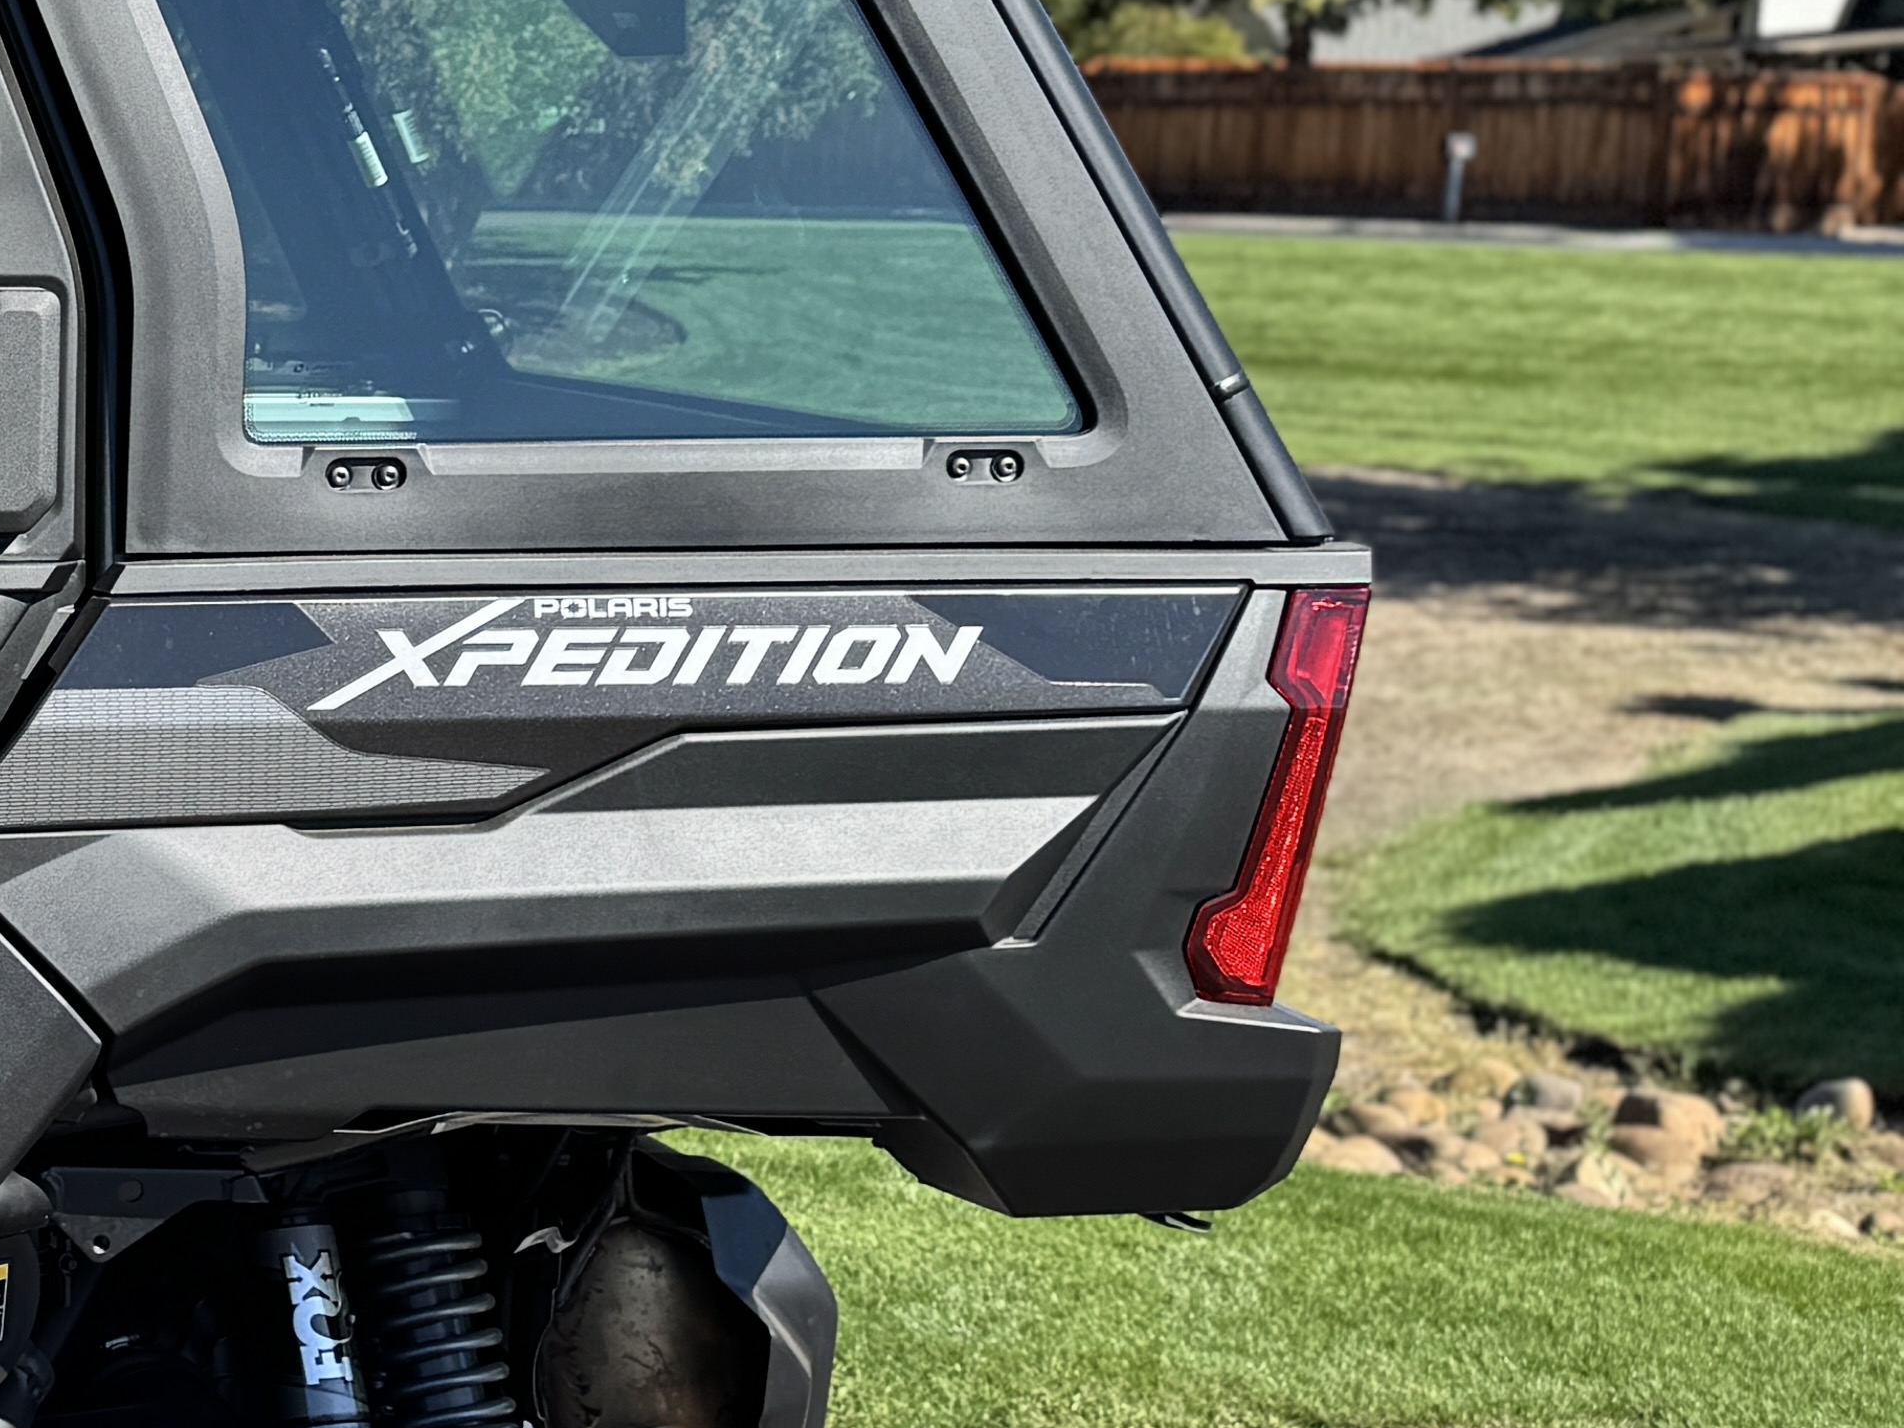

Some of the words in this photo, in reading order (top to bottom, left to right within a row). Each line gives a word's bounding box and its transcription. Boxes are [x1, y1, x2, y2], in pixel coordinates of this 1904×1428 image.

[307, 598, 984, 711] XPEDITION
[534, 597, 693, 618] POLARIS
[282, 1251, 354, 1386] FOX
